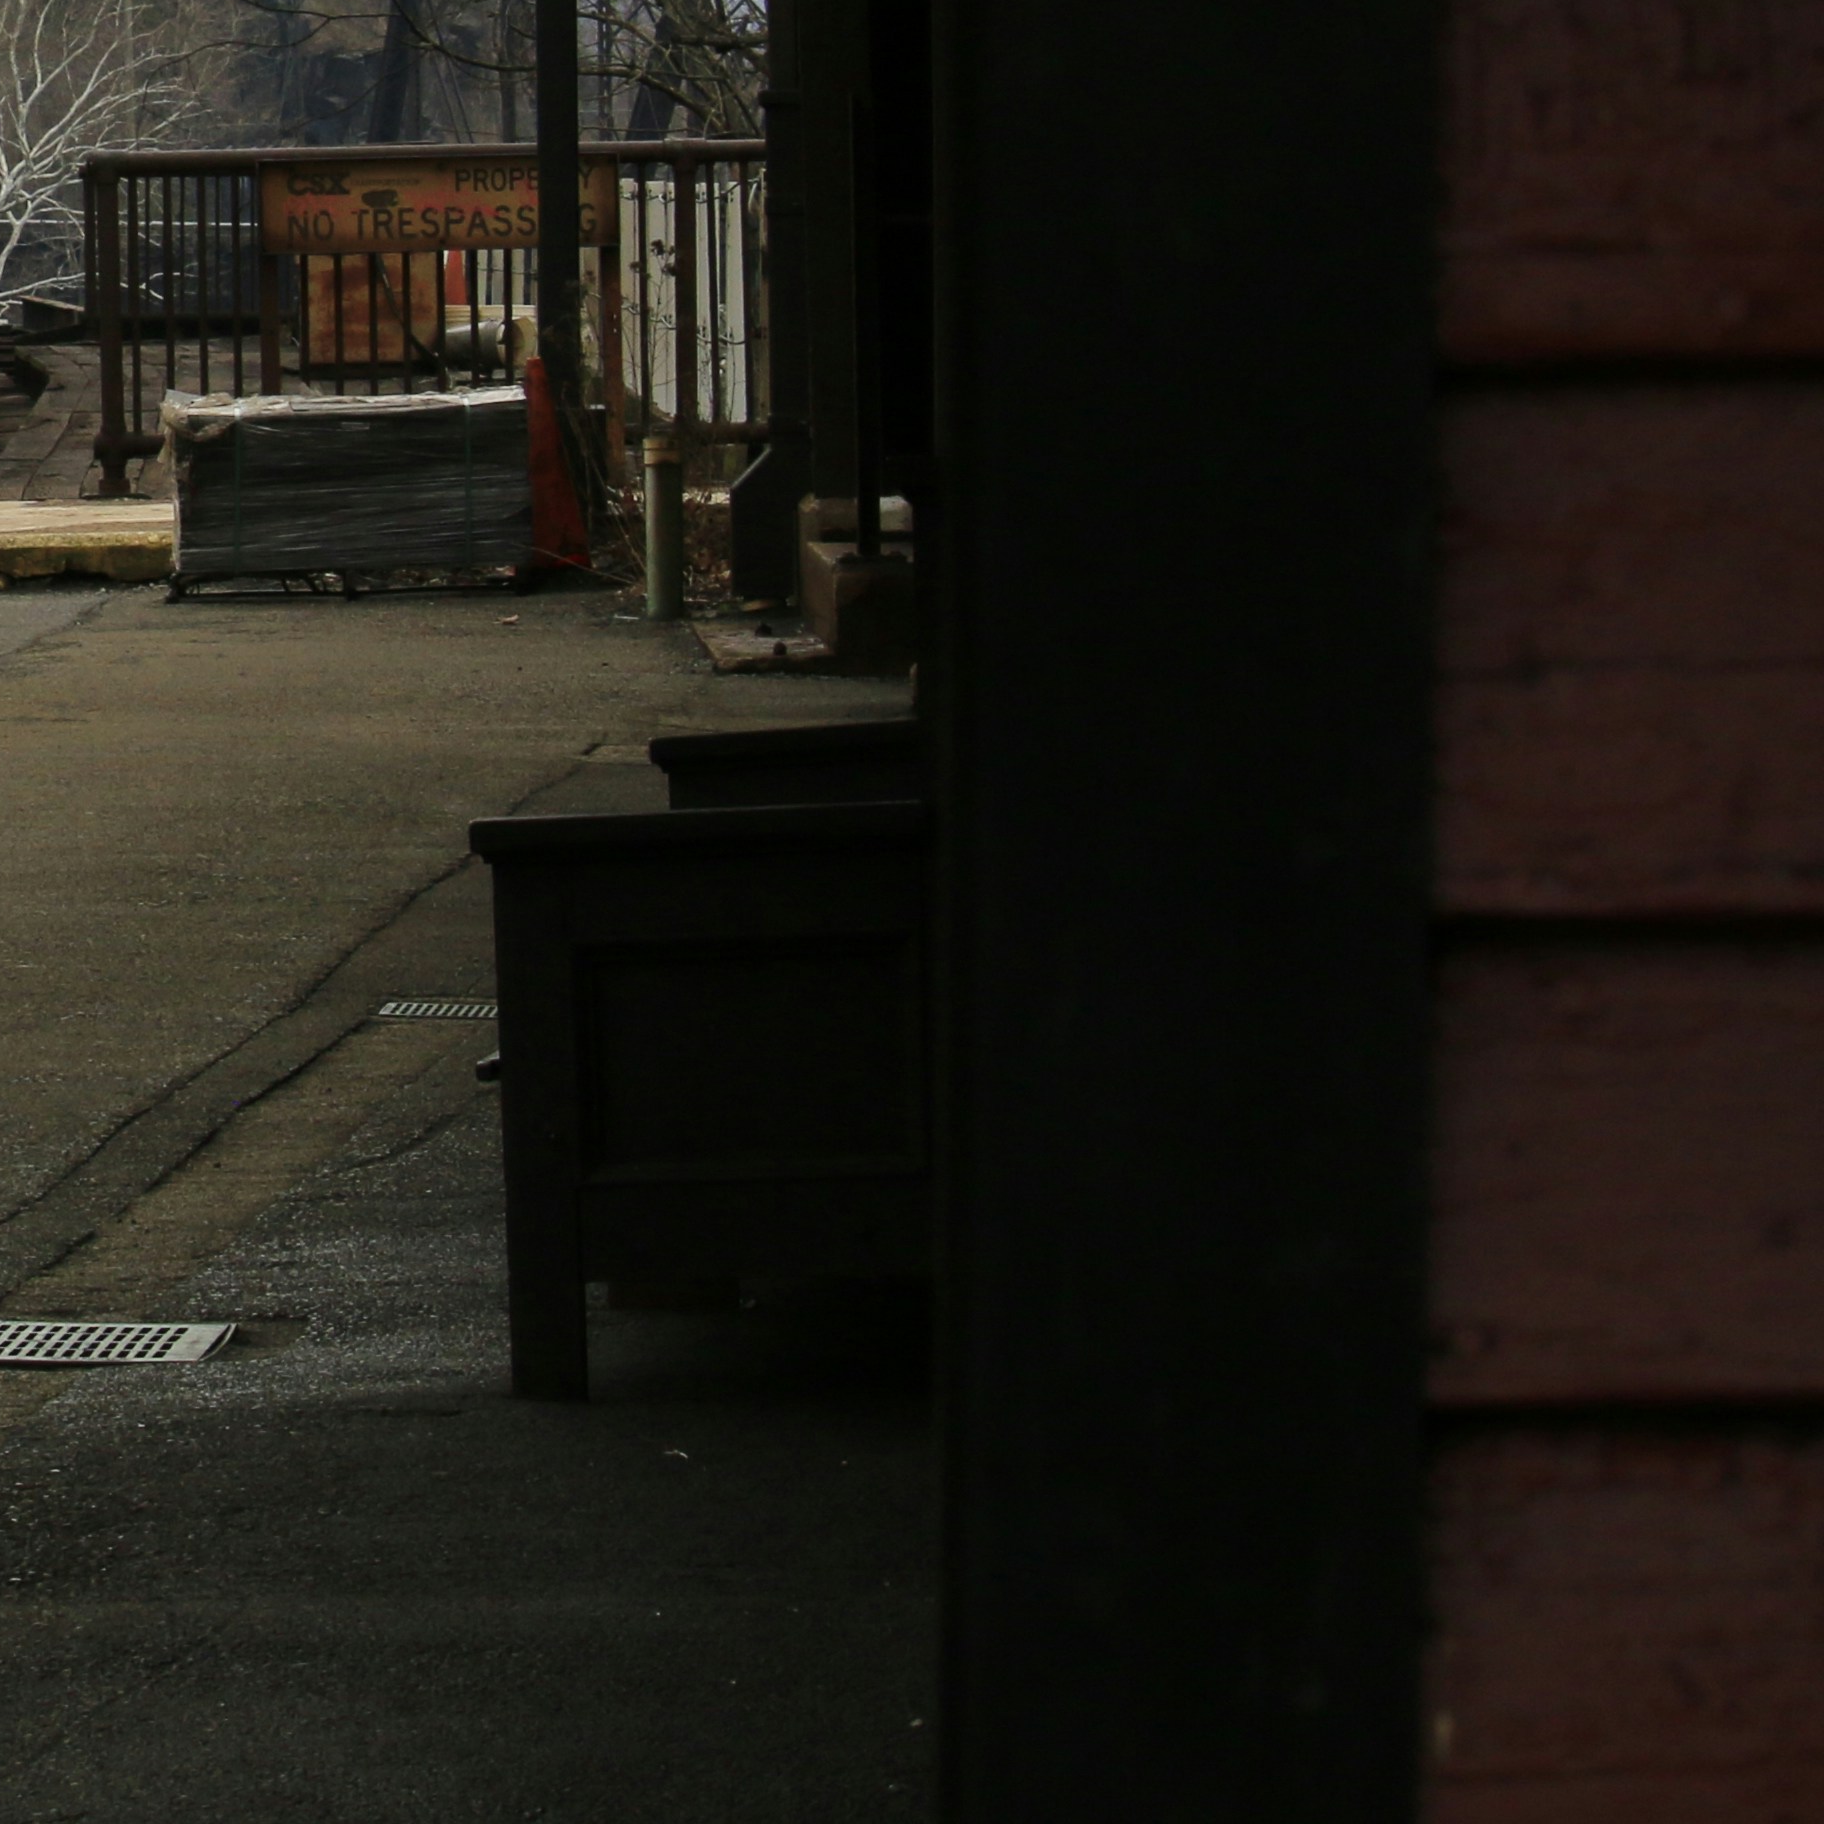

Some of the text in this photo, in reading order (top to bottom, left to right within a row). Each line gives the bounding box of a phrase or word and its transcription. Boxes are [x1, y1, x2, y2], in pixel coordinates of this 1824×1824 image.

[287, 167, 594, 194] CSX PROPEY
[288, 203, 597, 240] NO TRESPASSG
